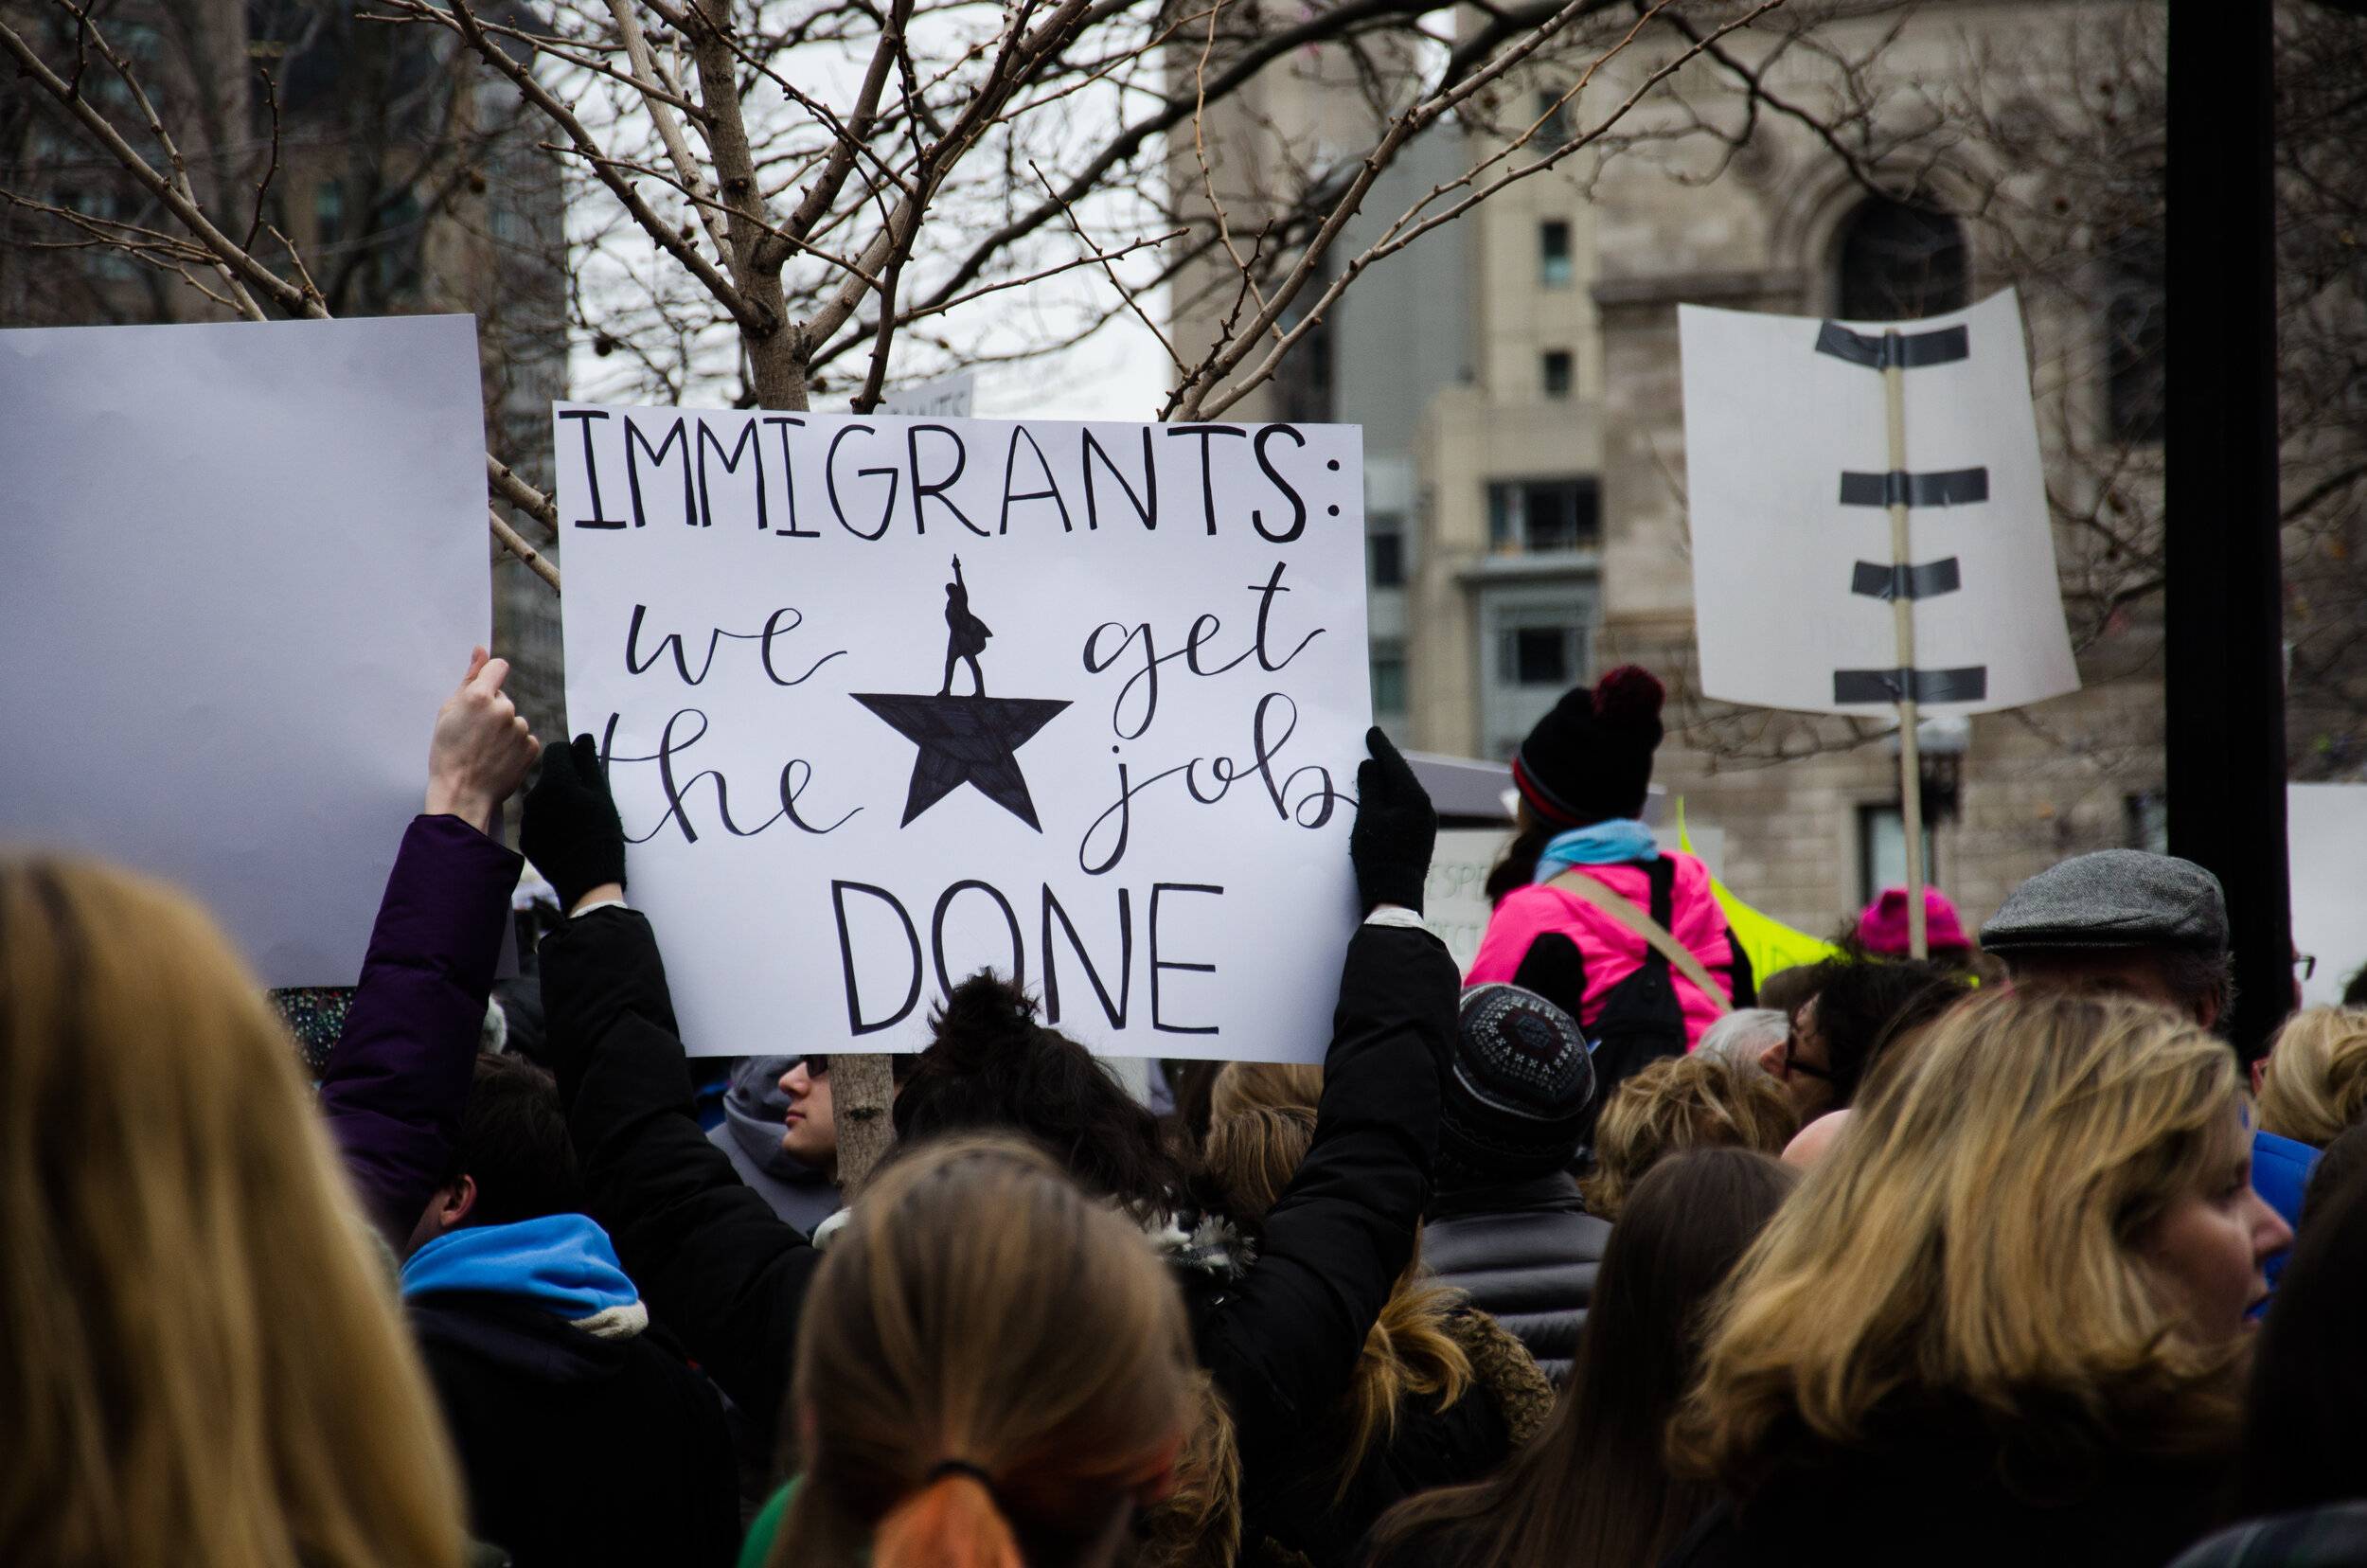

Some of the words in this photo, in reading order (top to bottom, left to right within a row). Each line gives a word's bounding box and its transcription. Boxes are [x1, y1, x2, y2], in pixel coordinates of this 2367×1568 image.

[559, 409, 1342, 544] IMMIGRANTS:
[626, 603, 847, 686] we
[1082, 561, 1326, 740] get
[598, 708, 864, 844] the
[1078, 691, 1358, 876] job
[830, 879, 1224, 1037] DONE
